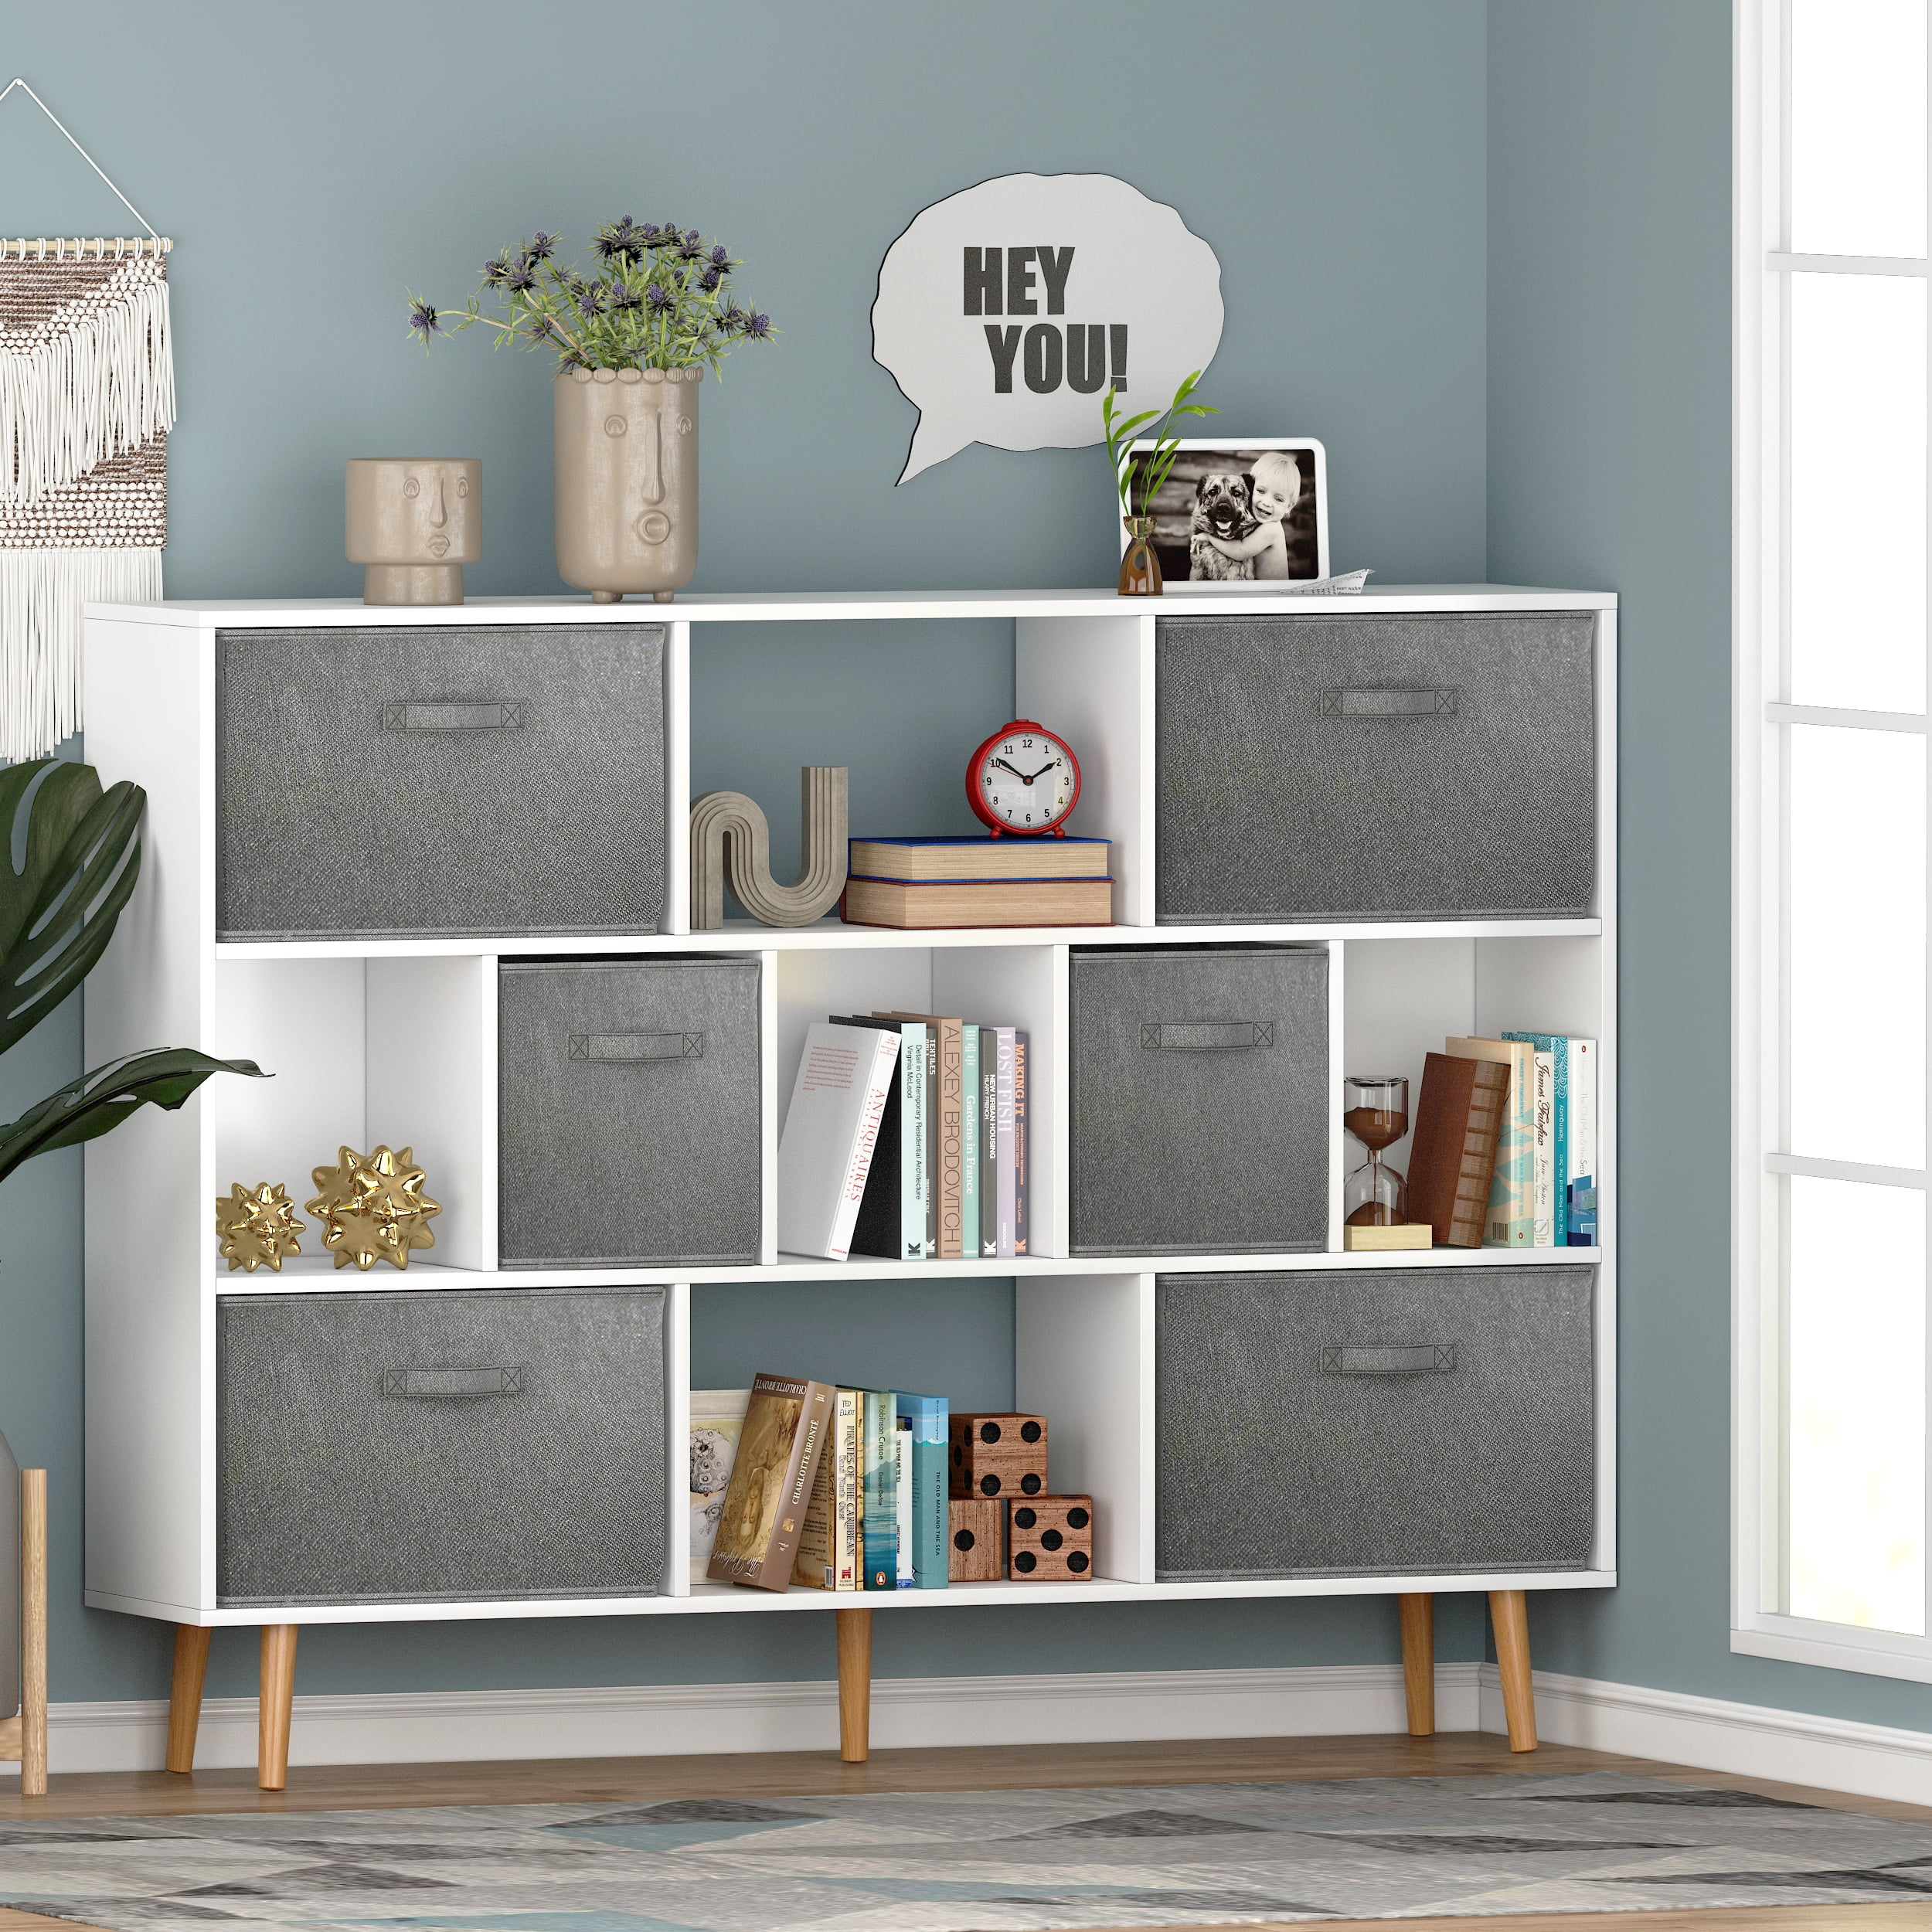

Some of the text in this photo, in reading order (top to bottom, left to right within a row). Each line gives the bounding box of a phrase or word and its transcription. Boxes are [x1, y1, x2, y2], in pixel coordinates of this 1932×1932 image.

[963, 246, 1075, 316] HEY
[984, 323, 1128, 393] YOU!
[1004, 745, 1014, 753] 11
[1022, 739, 1032, 748] 12
[1044, 745, 1049, 753] 1
[990, 759, 1001, 767] 10
[1056, 757, 1062, 767] 2
[986, 777, 992, 786] 9
[1063, 777, 1070, 786] 3
[993, 796, 998, 804] 8
[1007, 809, 1012, 818] 7
[1026, 814, 1031, 822] 6
[1044, 808, 1049, 818] 5
[998, 1034, 1012, 1131] LOST FISH
[1015, 1043, 1025, 1117] MAKING IT
[1534, 1057, 1550, 1145] James Fairfax
[944, 1026, 960, 1243] ALEXEY BRODOVITCH
[850, 1089, 886, 1202] ANTIQUAIRES
[966, 1095, 975, 1195] Gardens in France
[1540, 1155, 1549, 1175] Jane
[776, 1382, 807, 1395] CHARLOTTE
[792, 1454, 810, 1505] CHARLOTTE
[845, 1426, 855, 1556] PIRATES OF THE CARIBBEAN
[744, 1553, 761, 1578] The
